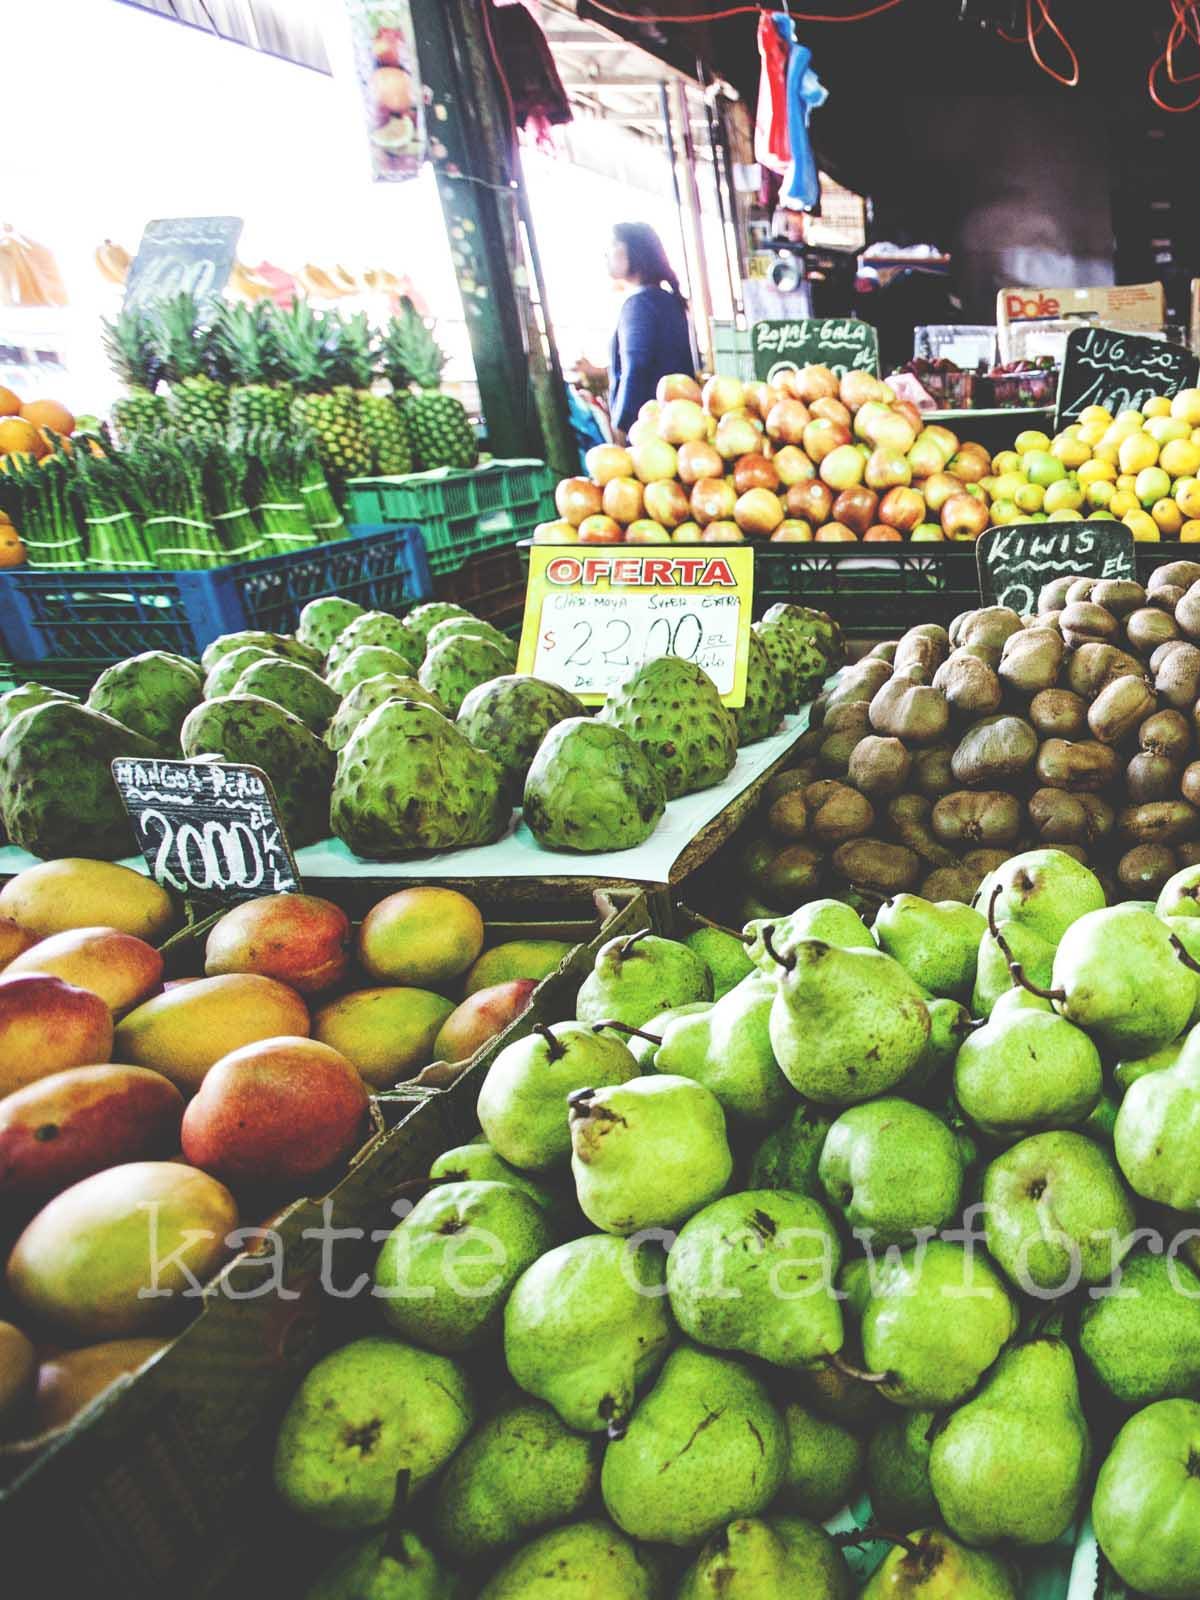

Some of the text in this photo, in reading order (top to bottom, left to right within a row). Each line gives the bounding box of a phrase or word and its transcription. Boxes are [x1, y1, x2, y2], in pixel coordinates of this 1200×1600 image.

[1006, 293, 1060, 318] Dole
[987, 529, 1096, 563] KIWIS
[546, 557, 737, 587] OFERTA
[139, 808, 264, 893] 2000
